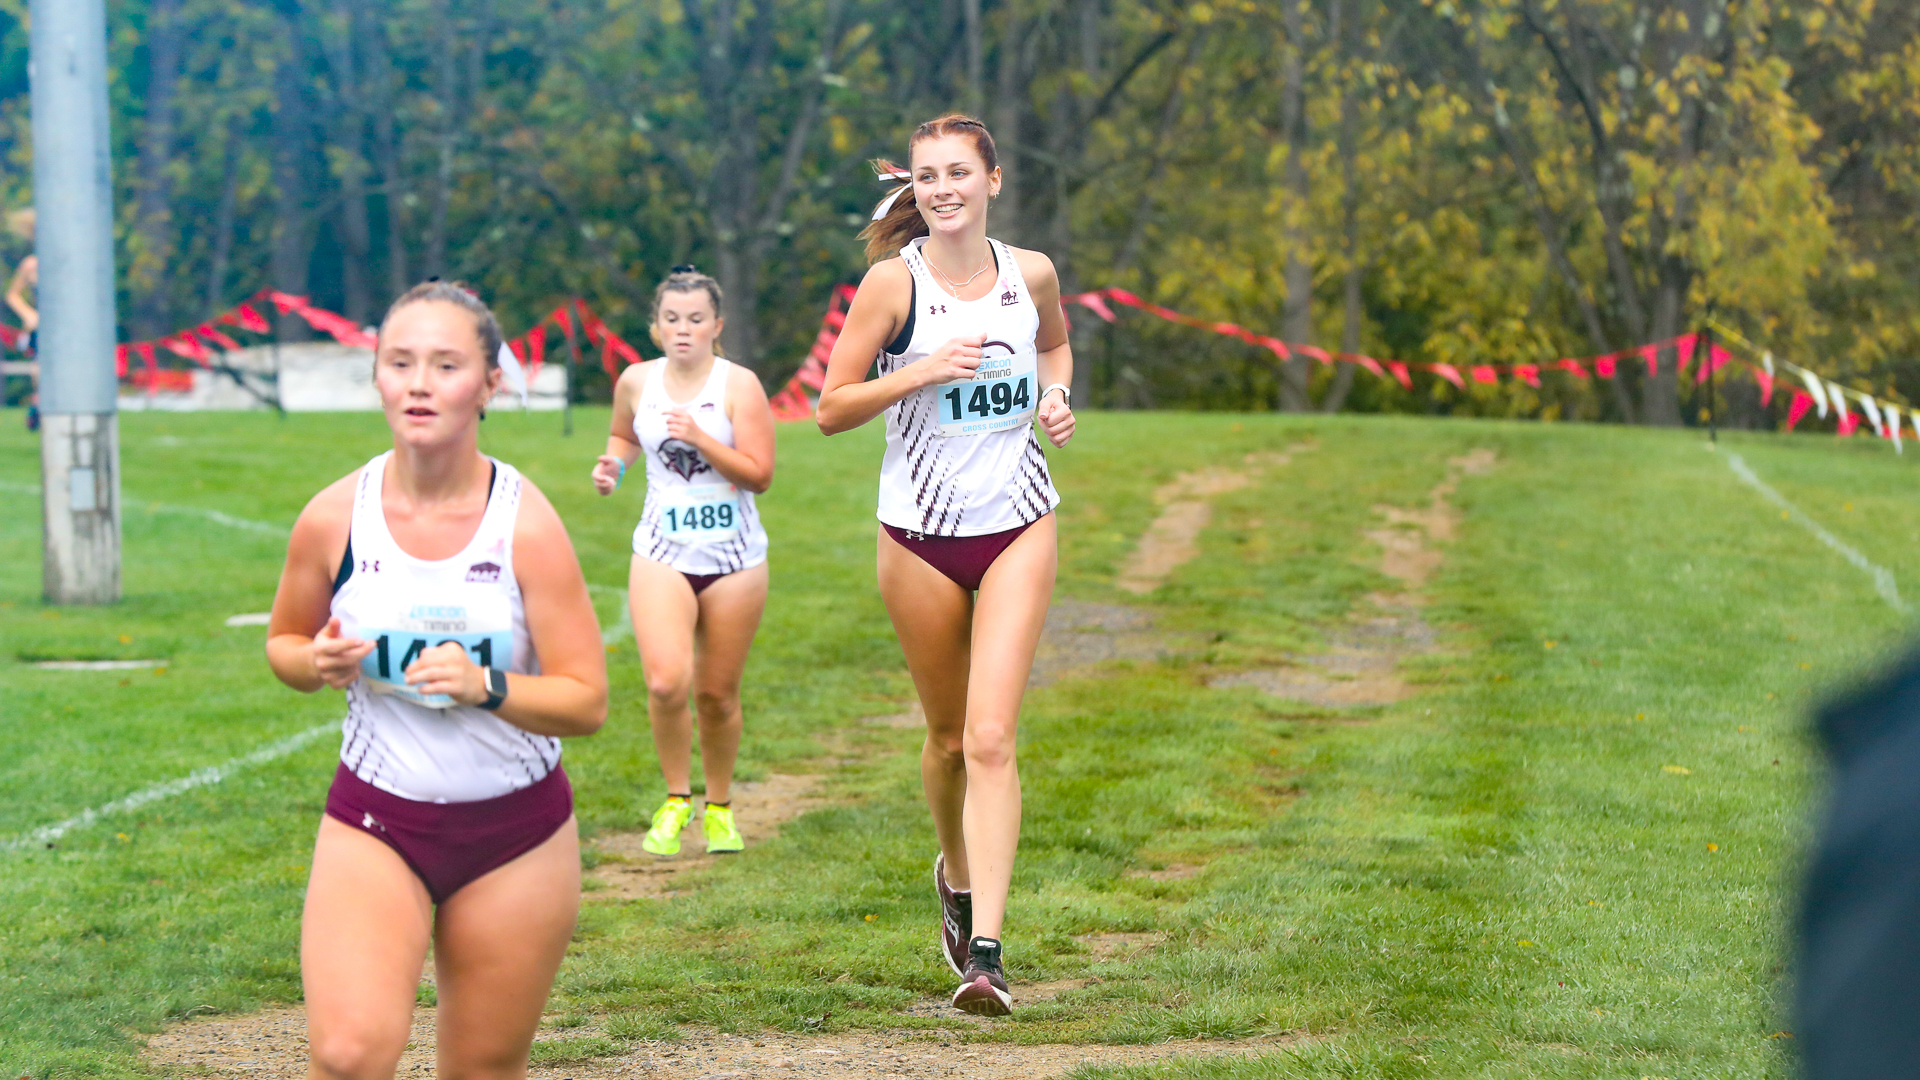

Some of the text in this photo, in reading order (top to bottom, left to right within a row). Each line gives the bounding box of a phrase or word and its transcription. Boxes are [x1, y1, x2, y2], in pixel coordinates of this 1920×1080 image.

[975, 358, 1011, 372] EXICON
[979, 368, 1012, 380] TIMING
[945, 377, 1030, 420] 1494
[962, 417, 1019, 432] CROSS COUNTRY
[666, 504, 733, 531] 1489
[377, 635, 492, 678] 141
